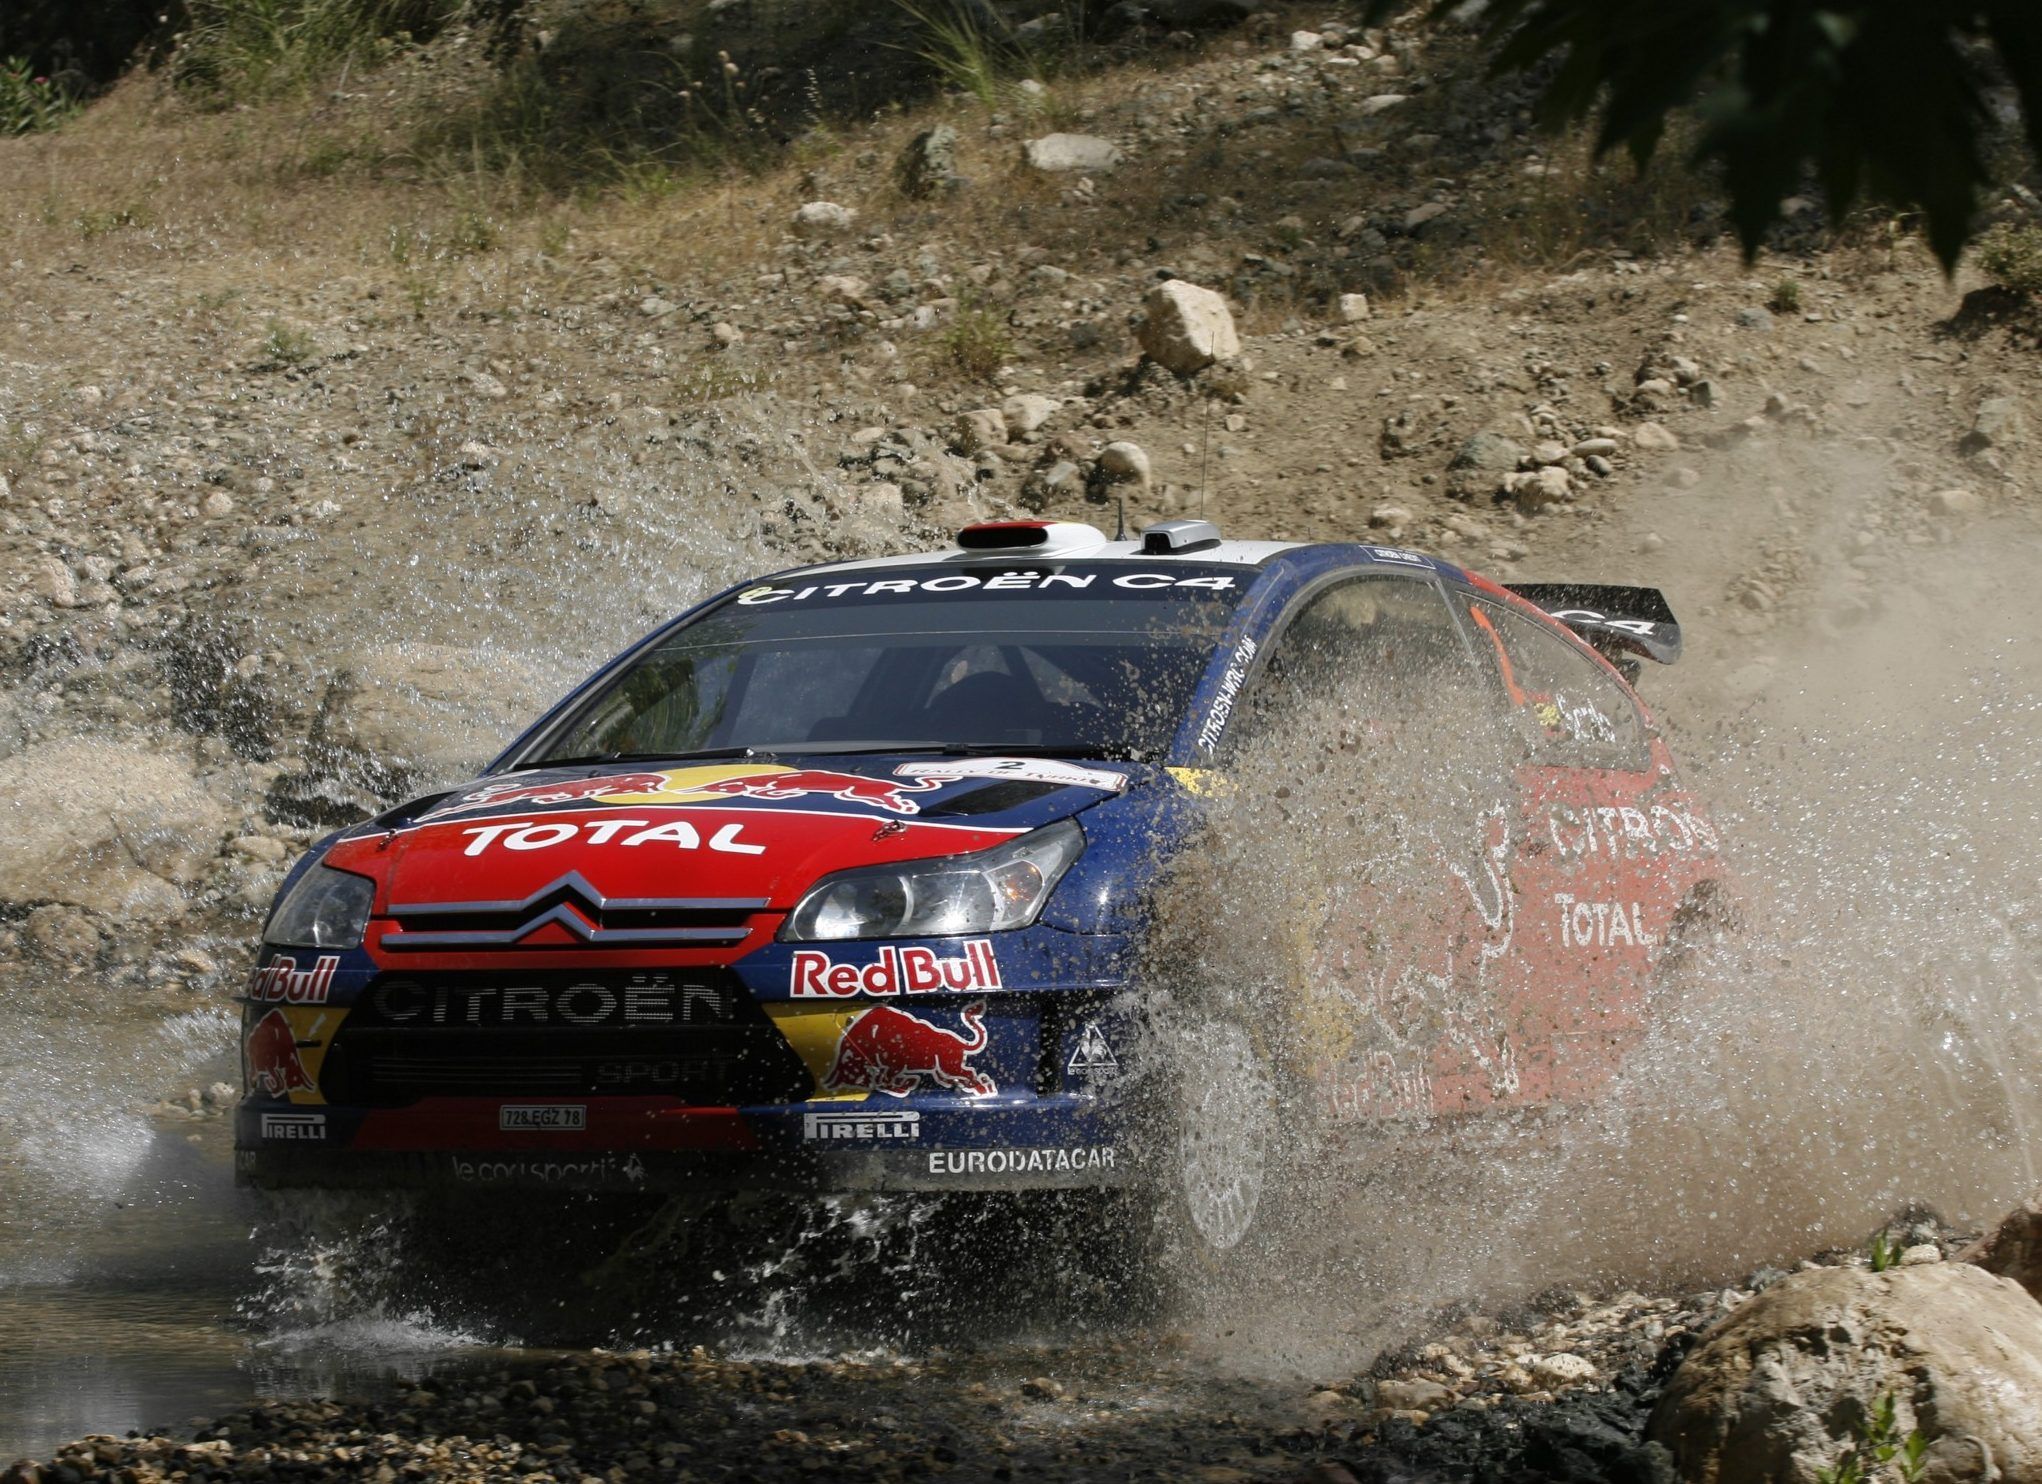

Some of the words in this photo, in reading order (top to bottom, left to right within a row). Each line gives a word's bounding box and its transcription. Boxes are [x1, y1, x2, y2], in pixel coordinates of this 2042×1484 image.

[738, 571, 1095, 605] CITROËN
[1112, 573, 1235, 591] C4
[1551, 609, 1656, 636] C4
[995, 761, 1026, 770] 2
[463, 820, 767, 857] TOTAL
[1555, 893, 1658, 947] TOTAL
[790, 946, 898, 998] Red
[899, 939, 1002, 995] Bull
[374, 976, 734, 1023] CITROËN
[262, 1113, 326, 1139] PIRELLI
[506, 1110, 528, 1125] 728
[532, 1110, 560, 1126] EGZ
[565, 1110, 581, 1125] 78
[804, 1111, 920, 1139] PIRELLI
[929, 1147, 1115, 1175] EURODATACAR
